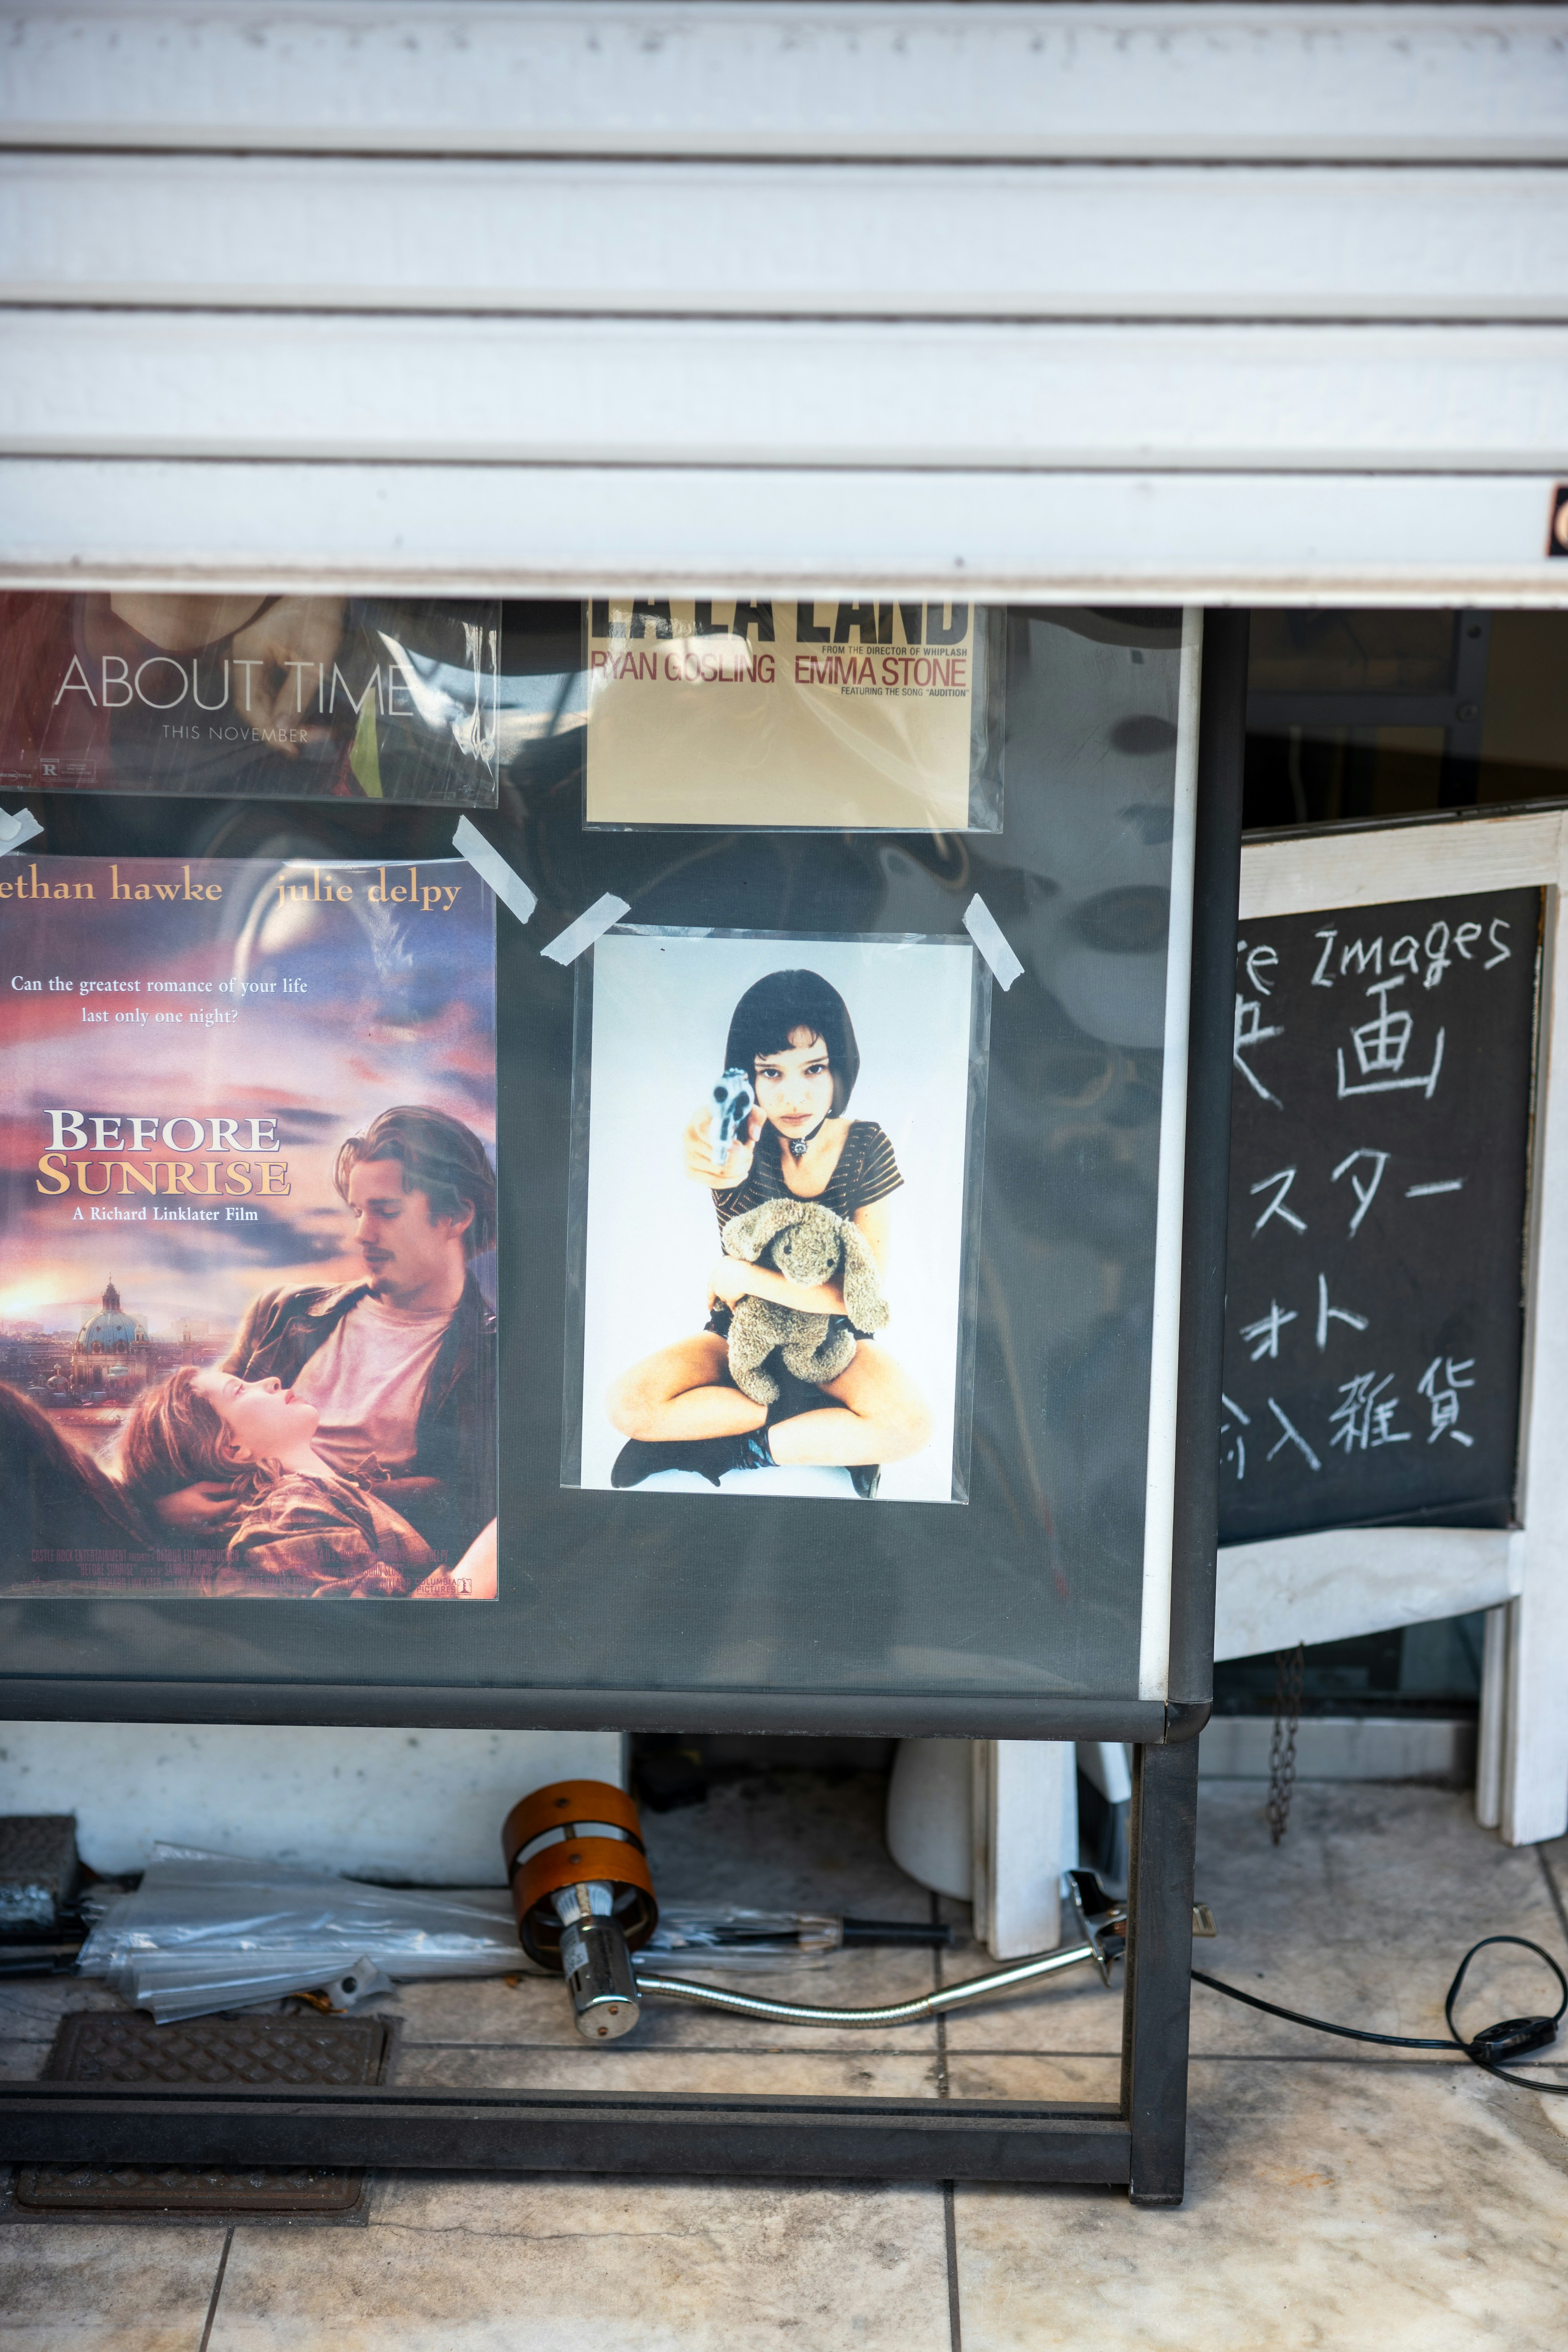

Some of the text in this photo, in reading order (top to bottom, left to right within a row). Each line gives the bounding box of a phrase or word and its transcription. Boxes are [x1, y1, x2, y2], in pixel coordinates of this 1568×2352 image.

[822, 646, 968, 656] FROM THE DIRECTOR OF WHIPLASH
[590, 651, 966, 687] RYAN GOSLING EMMA STONE
[54, 654, 414, 716] ABOUT TIME
[841, 687, 883, 695] FEATURING
[885, 688, 900, 696] THE
[902, 688, 923, 696] SONG
[162, 725, 308, 743] THIS NOVEMBER
[42, 764, 58, 776] R
[0, 863, 223, 901] ethan hawke
[275, 866, 462, 912] julie delpy
[1311, 918, 1511, 990] Images
[11, 976, 308, 997] Can the greatest romance of your life
[82, 1007, 238, 1028] last only one night?
[44, 1109, 282, 1152] BEFORE
[36, 1153, 291, 1197] SUNRISE
[72, 1207, 259, 1221] A Richard Linklater Film
[31, 1549, 54, 1562] CASTLE
[56, 1549, 73, 1562] ROCK
[75, 1549, 127, 1562] ENTERTAINMENT
[157, 1549, 182, 1562] DETOUR
[429, 1549, 448, 1562] DELPY
